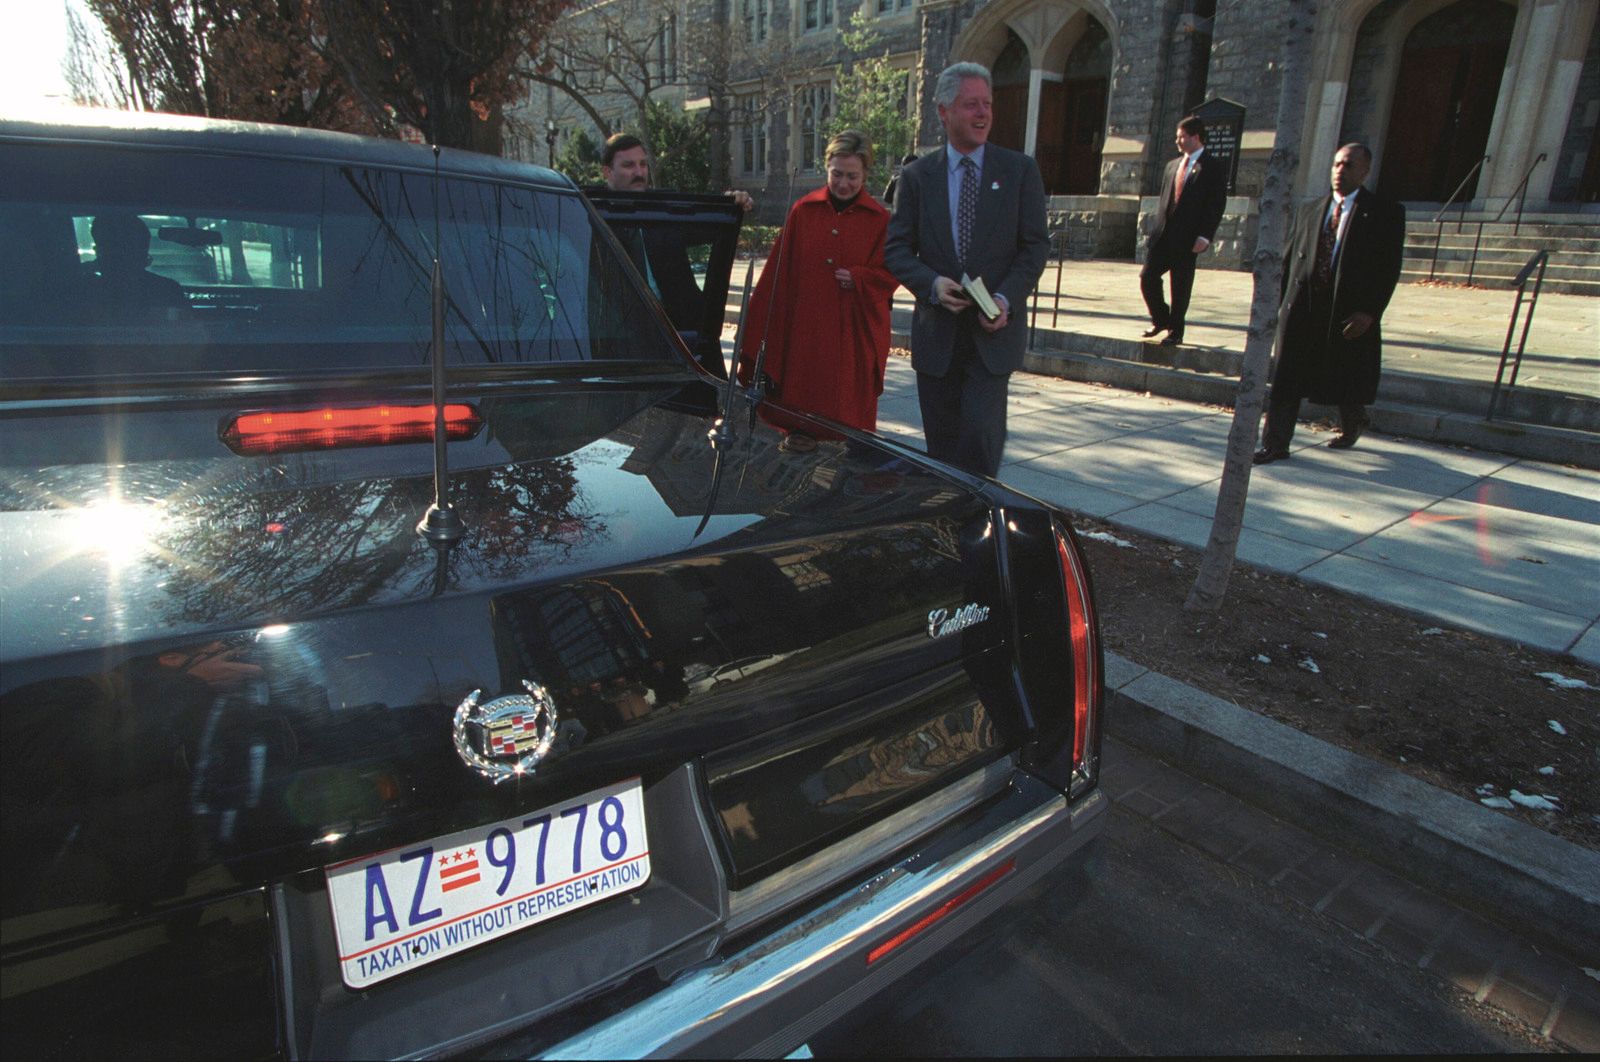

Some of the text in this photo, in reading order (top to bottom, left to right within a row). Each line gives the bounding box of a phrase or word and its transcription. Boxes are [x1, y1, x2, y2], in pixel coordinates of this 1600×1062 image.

[357, 861, 640, 978] TAXATION WITHOUT REPRESENTATION
[364, 796, 628, 942] AZ 9778
